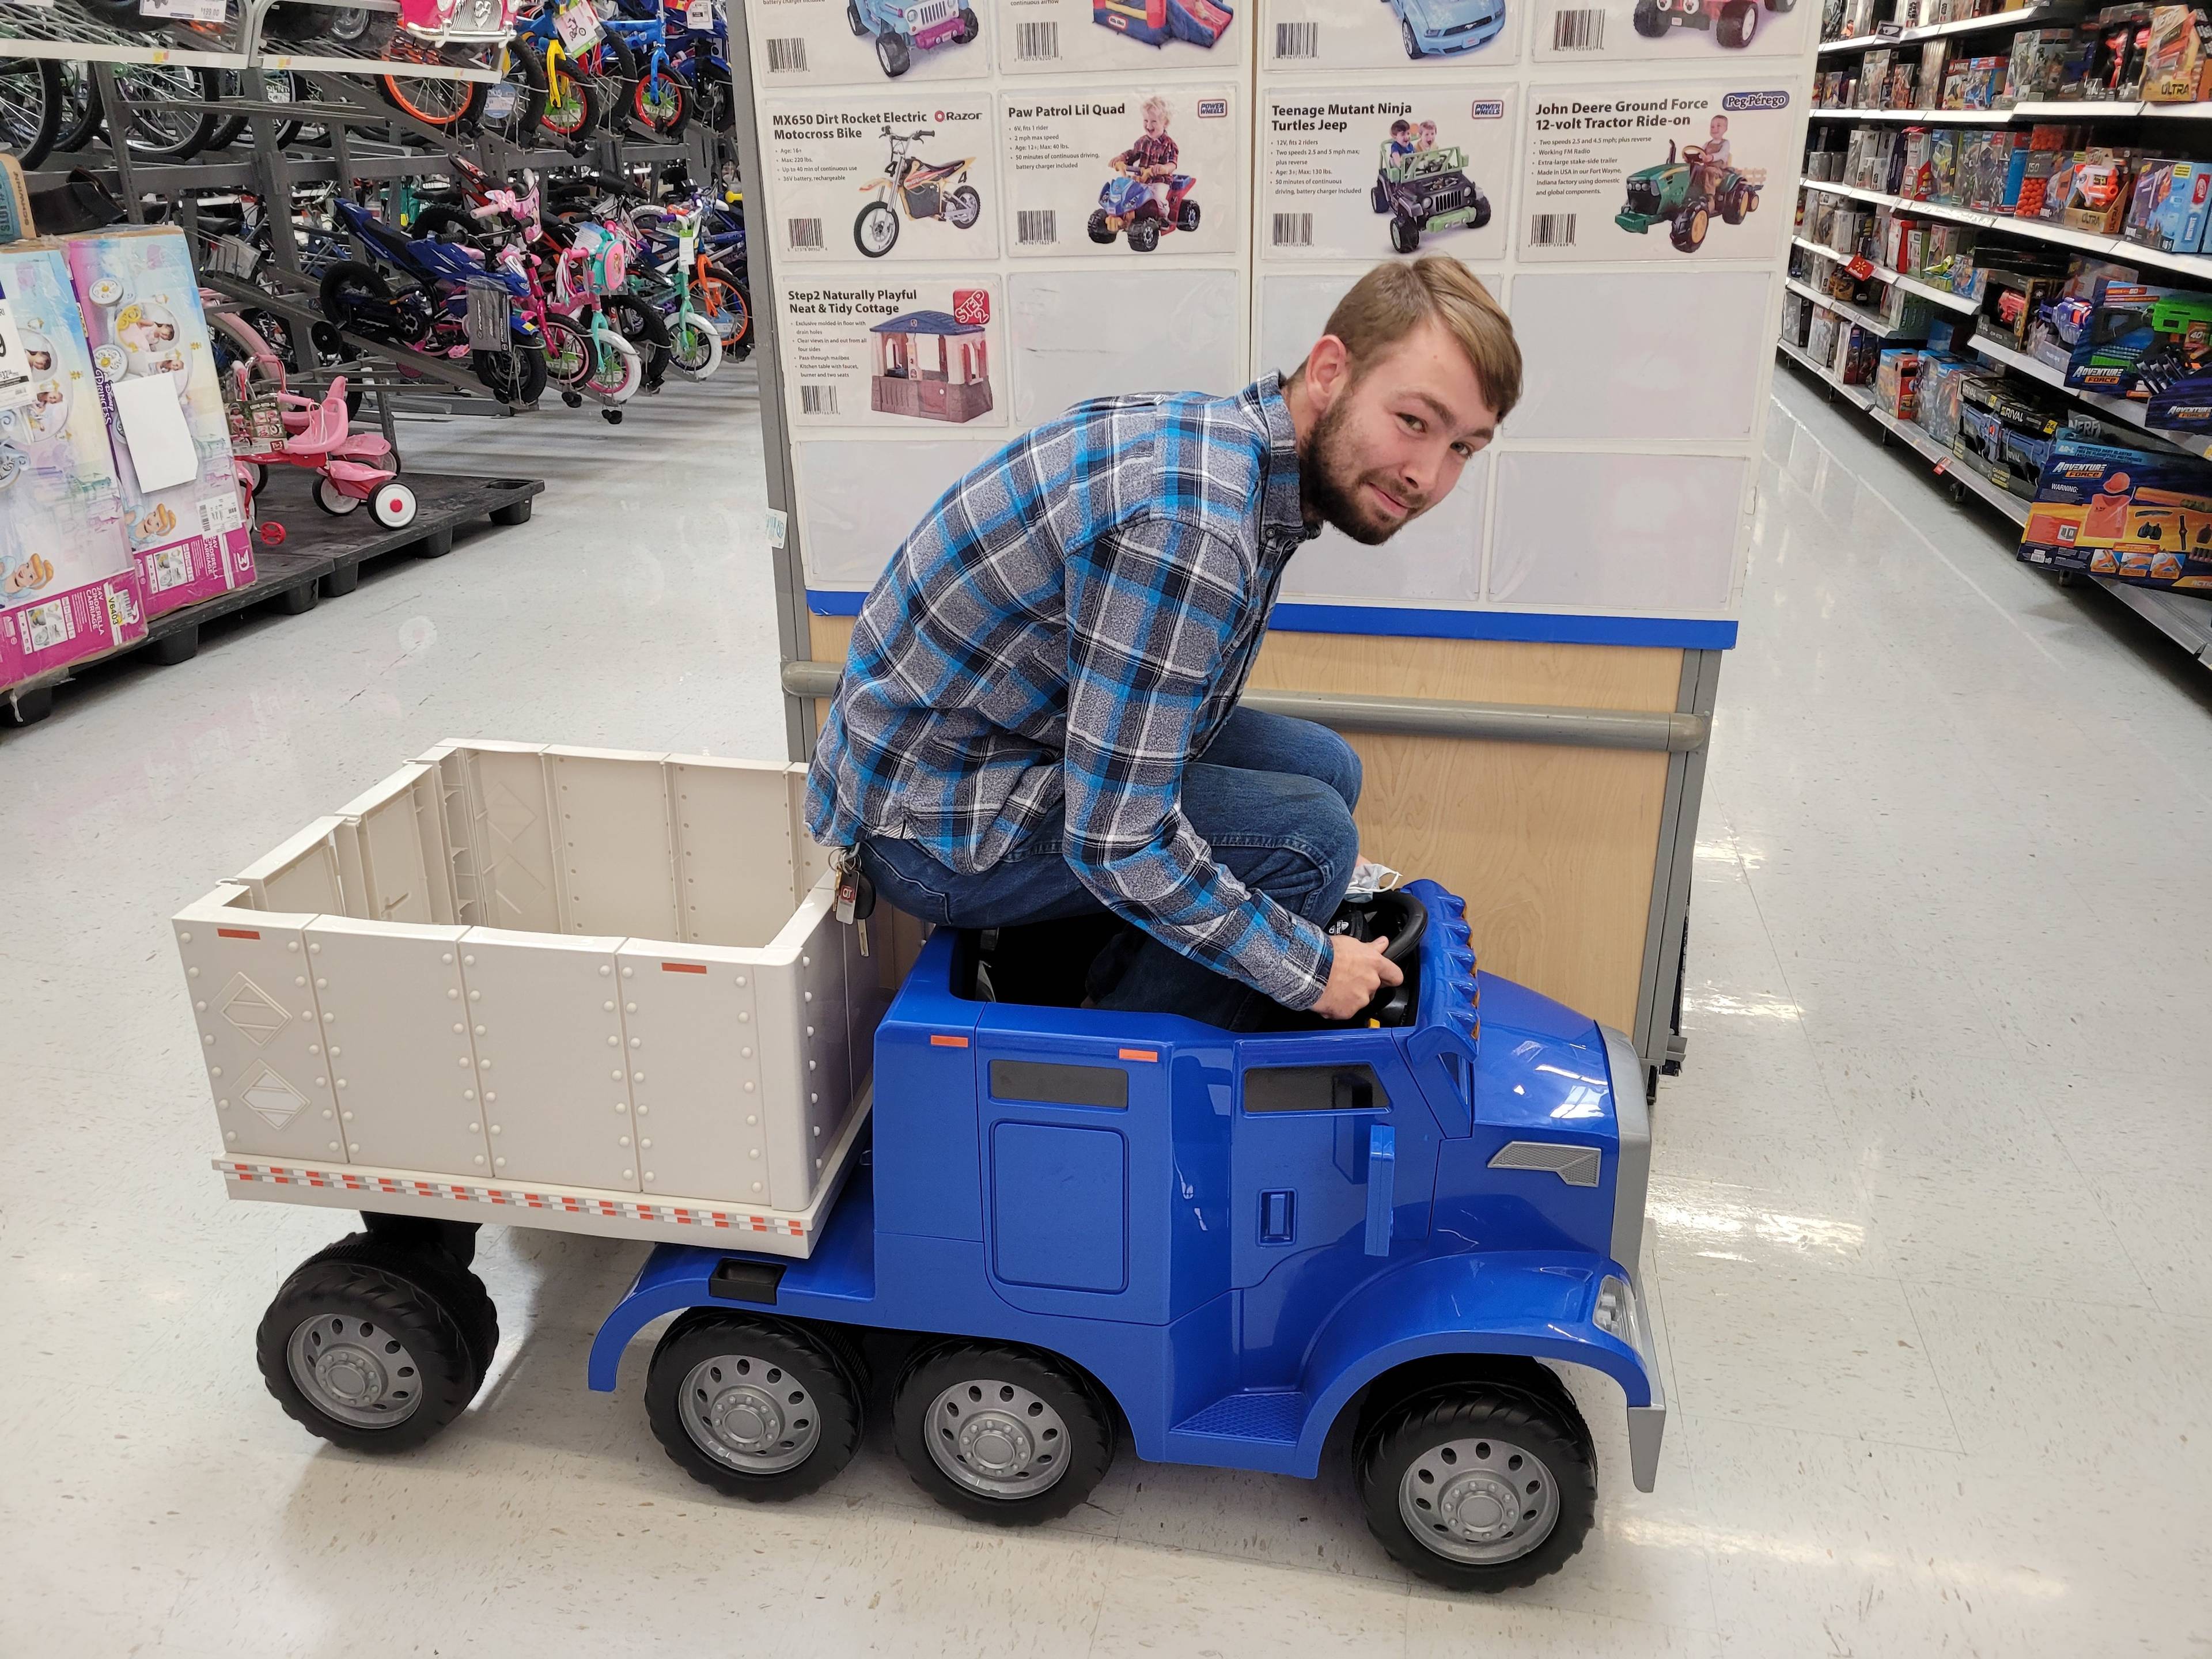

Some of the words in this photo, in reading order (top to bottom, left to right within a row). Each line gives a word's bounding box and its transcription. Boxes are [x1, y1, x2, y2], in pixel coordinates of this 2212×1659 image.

[2161, 84, 2189, 95] ULTRA
[1009, 107, 1033, 118] Paw
[1036, 104, 1072, 117] Patrol
[1075, 104, 1089, 116] Lil
[1092, 103, 1125, 116] Quad
[1271, 105, 1325, 117] Teenage
[1328, 104, 1375, 115] Mutant
[1378, 102, 1412, 116] Ninja
[1535, 103, 1568, 115] John
[1571, 103, 1612, 114] Deere
[1615, 99, 1668, 112] Ground
[1671, 99, 1709, 110] Force
[772, 115, 813, 126] MX650
[816, 113, 839, 125] Dirt
[841, 112, 881, 124] Rocket
[884, 111, 927, 123] Electric
[946, 111, 983, 122] Razor
[1536, 118, 1582, 131] 12-volt
[1584, 117, 1634, 129] Tractor
[1636, 115, 1691, 127] Ride-on
[1271, 119, 1315, 131] Turtles
[1317, 119, 1347, 133] Jeep
[774, 129, 834, 140] Motocross
[836, 127, 862, 139] Bike
[1551, 138, 1571, 147] speeds
[1618, 136, 1630, 145] plus
[1333, 148, 1346, 156] mph
[2028, 162, 2040, 173] 150
[957, 171, 968, 184] 4
[13, 171, 29, 226] SCHWINN
[1316, 188, 1338, 196] charger
[2082, 213, 2100, 226] ULTRA
[788, 290, 820, 303] Step2
[823, 289, 875, 302] Naturally
[877, 289, 917, 302] Playful
[789, 304, 816, 313] Neat
[818, 303, 827, 313] &
[828, 302, 853, 316] Tidy
[855, 303, 899, 316] Cottage
[955, 289, 985, 324] STEP
[975, 309, 989, 323] 2
[2073, 366, 2124, 377] ADVENTURE
[95, 369, 112, 425] PRINCESS
[2005, 408, 2024, 423] RIVAL
[2167, 406, 2212, 414] ADVENTURE
[2052, 461, 2107, 473] ADVENTURE
[2051, 483, 2078, 493] WARNING:
[203, 537, 213, 575] CARRIAGE
[96, 586, 104, 600] 24V
[86, 589, 99, 630] CARRIAGE
[92, 588, 106, 636] CINDERELLA
[108, 597, 119, 626] V6403
[843, 888, 853, 899] QT
